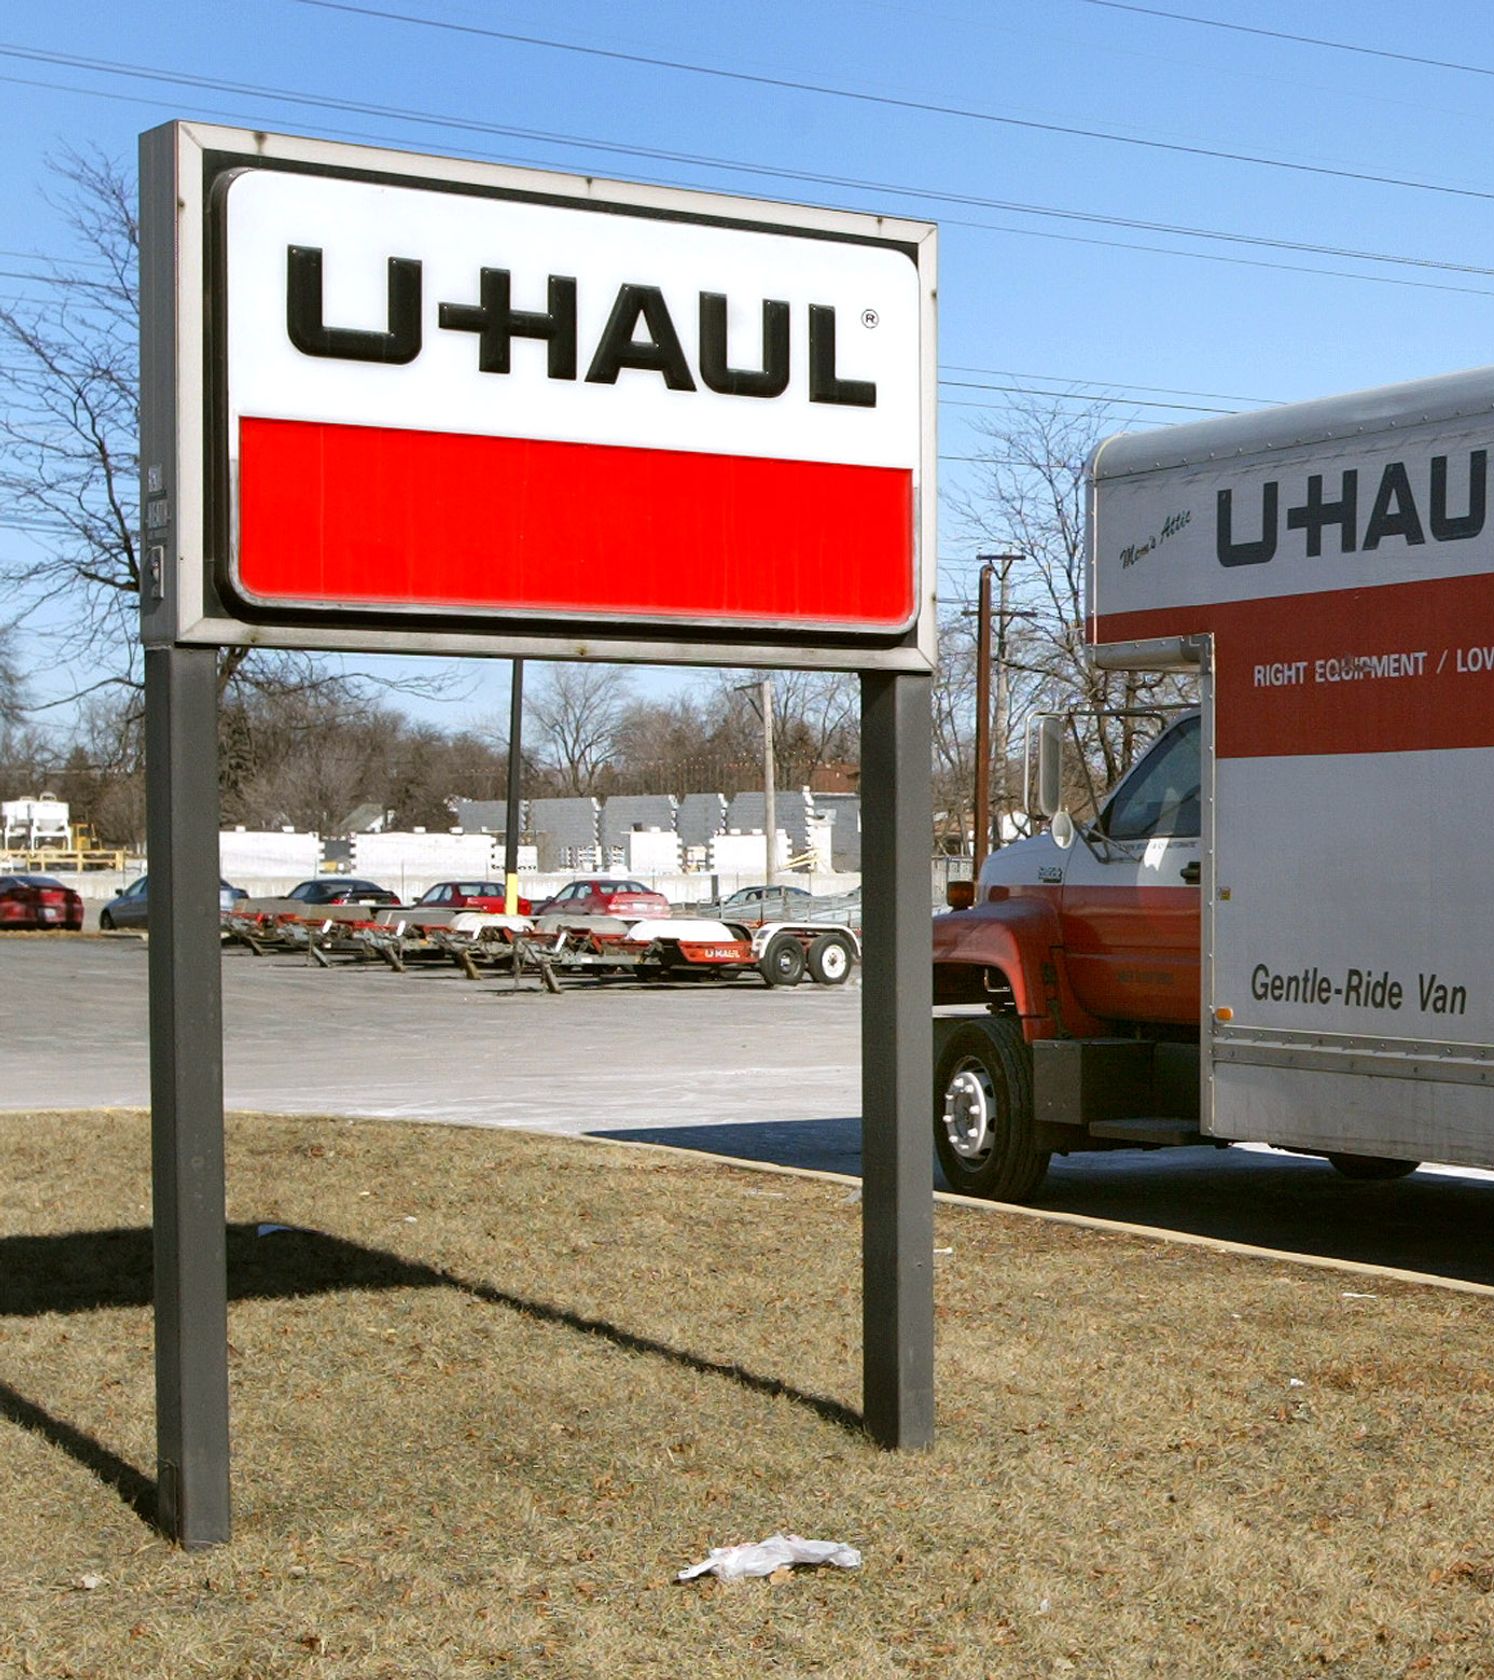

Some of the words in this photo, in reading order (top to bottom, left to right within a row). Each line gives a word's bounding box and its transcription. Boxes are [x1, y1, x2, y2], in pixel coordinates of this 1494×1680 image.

[1254, 661, 1308, 687] RIGHT
[1315, 651, 1428, 683] EQUIPMENT
[1252, 963, 1403, 1010] Gentle-Ride
[1419, 973, 1467, 1014] Van
